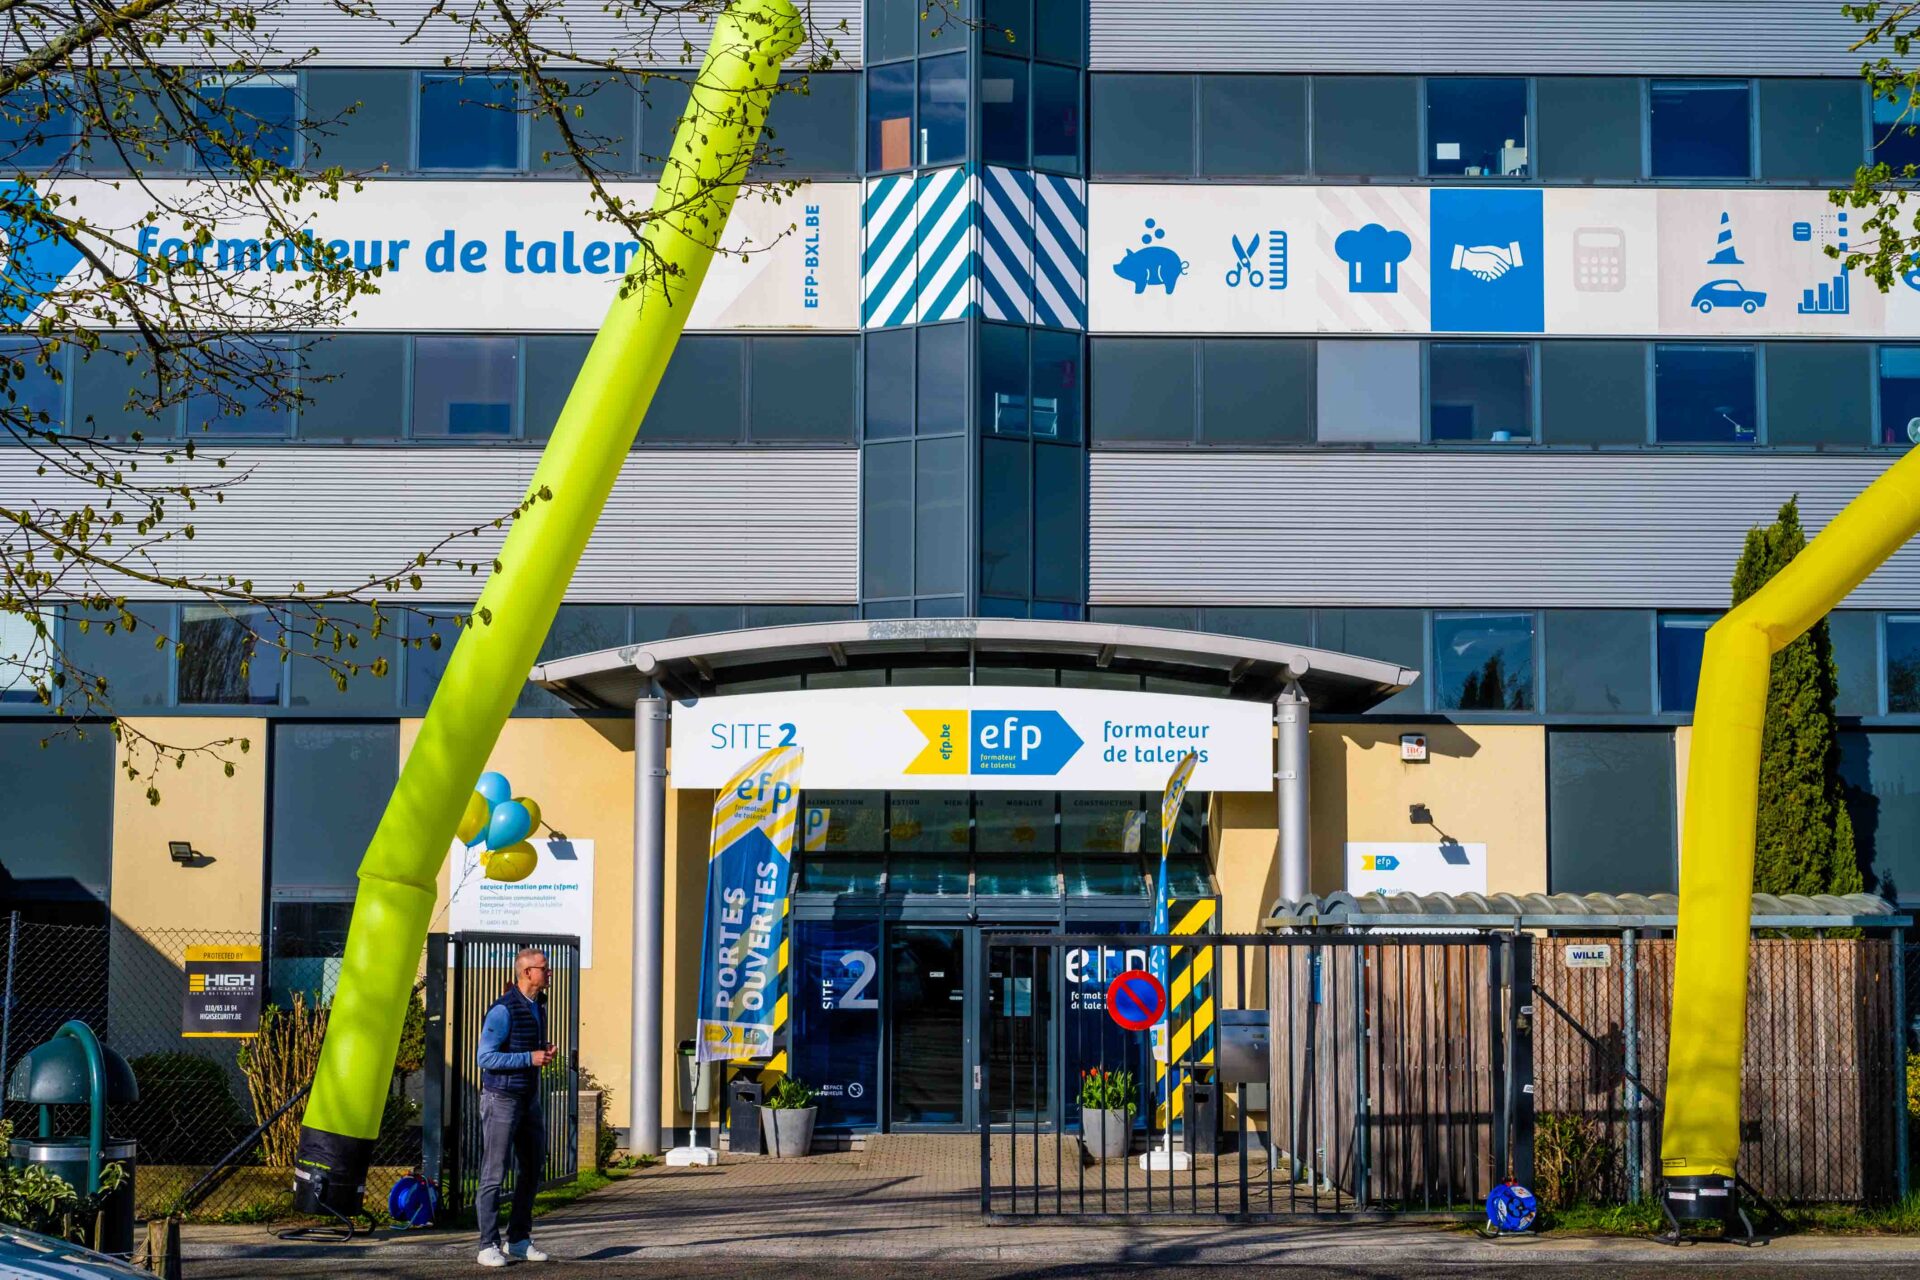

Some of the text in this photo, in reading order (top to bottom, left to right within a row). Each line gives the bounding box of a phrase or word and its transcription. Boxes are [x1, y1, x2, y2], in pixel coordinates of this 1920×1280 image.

[425, 230, 487, 273] de
[804, 205, 819, 308] EFP-BXL.BE
[711, 722, 797, 749] SITE 2
[939, 723, 952, 760] efp.be
[980, 716, 1042, 761] efp
[1104, 720, 1210, 742] formateur
[980, 753, 1016, 762] formateur
[1103, 745, 1127, 763] de
[736, 772, 792, 814] efp
[1376, 857, 1391, 868] efp
[716, 887, 746, 1009] PORTES
[742, 861, 779, 1011] OUVERTES
[203, 952, 235, 960] PROTECTED
[1572, 951, 1604, 959] WILLE
[205, 974, 255, 986] HIGH
[822, 979, 834, 1010] SITE
[839, 951, 879, 1009] 2
